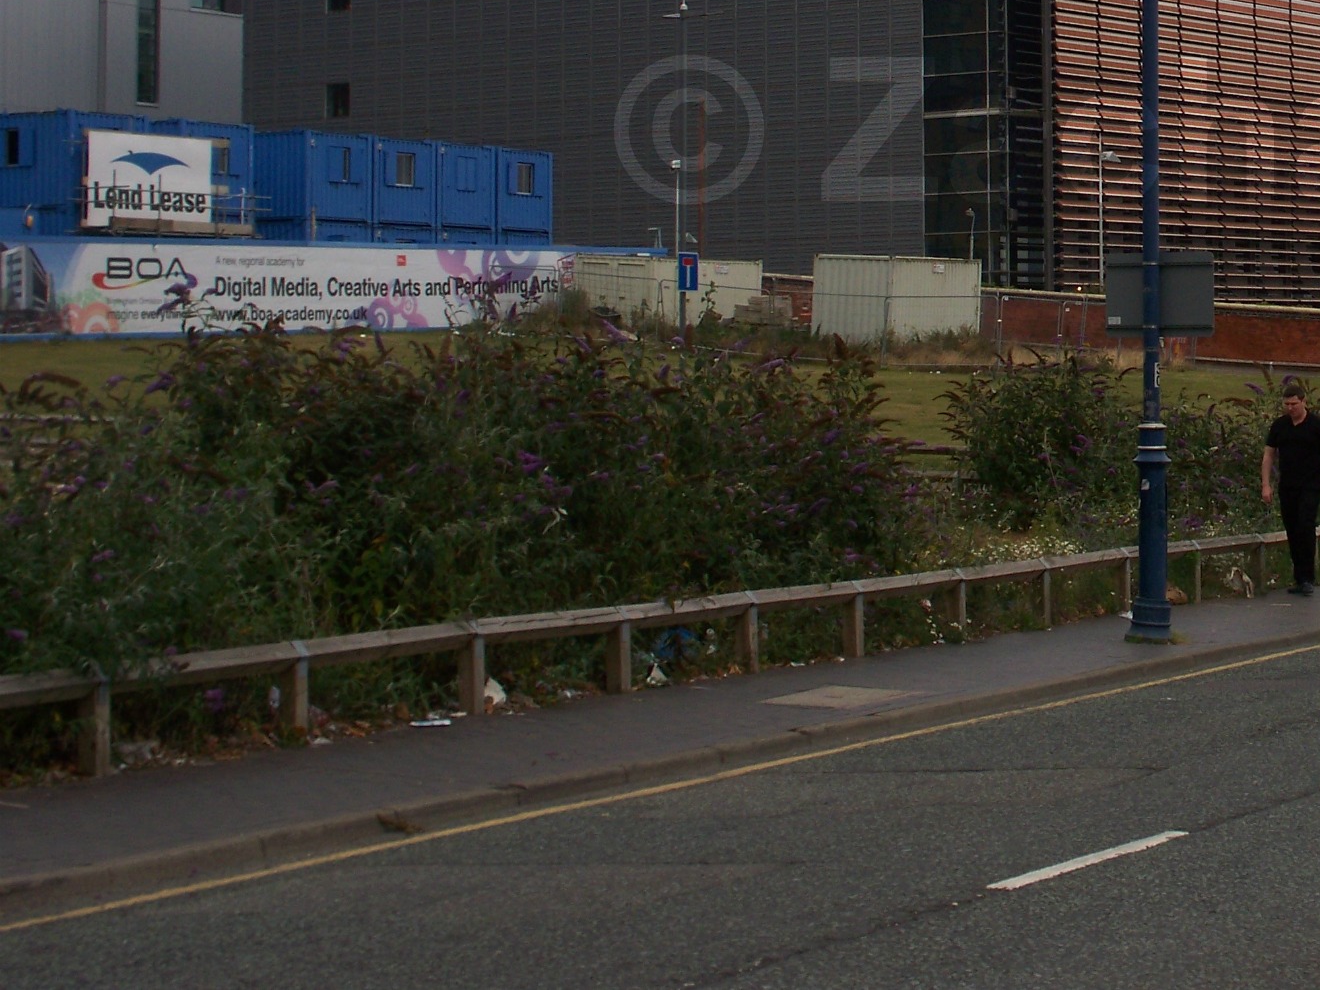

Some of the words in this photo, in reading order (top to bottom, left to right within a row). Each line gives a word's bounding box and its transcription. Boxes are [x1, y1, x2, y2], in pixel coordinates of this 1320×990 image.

[94, 181, 143, 210] Lend
[149, 184, 206, 213] Lease
[106, 257, 188, 279] BOA
[215, 276, 266, 302] Digital
[271, 276, 322, 300] Media,
[327, 276, 388, 297] Creative
[392, 277, 421, 297] Arts
[425, 275, 450, 297] and
[455, 275, 529, 297] Perfoming
[531, 275, 558, 293] Arts
[215, 306, 368, 324] www.boa-academy.co.uk
